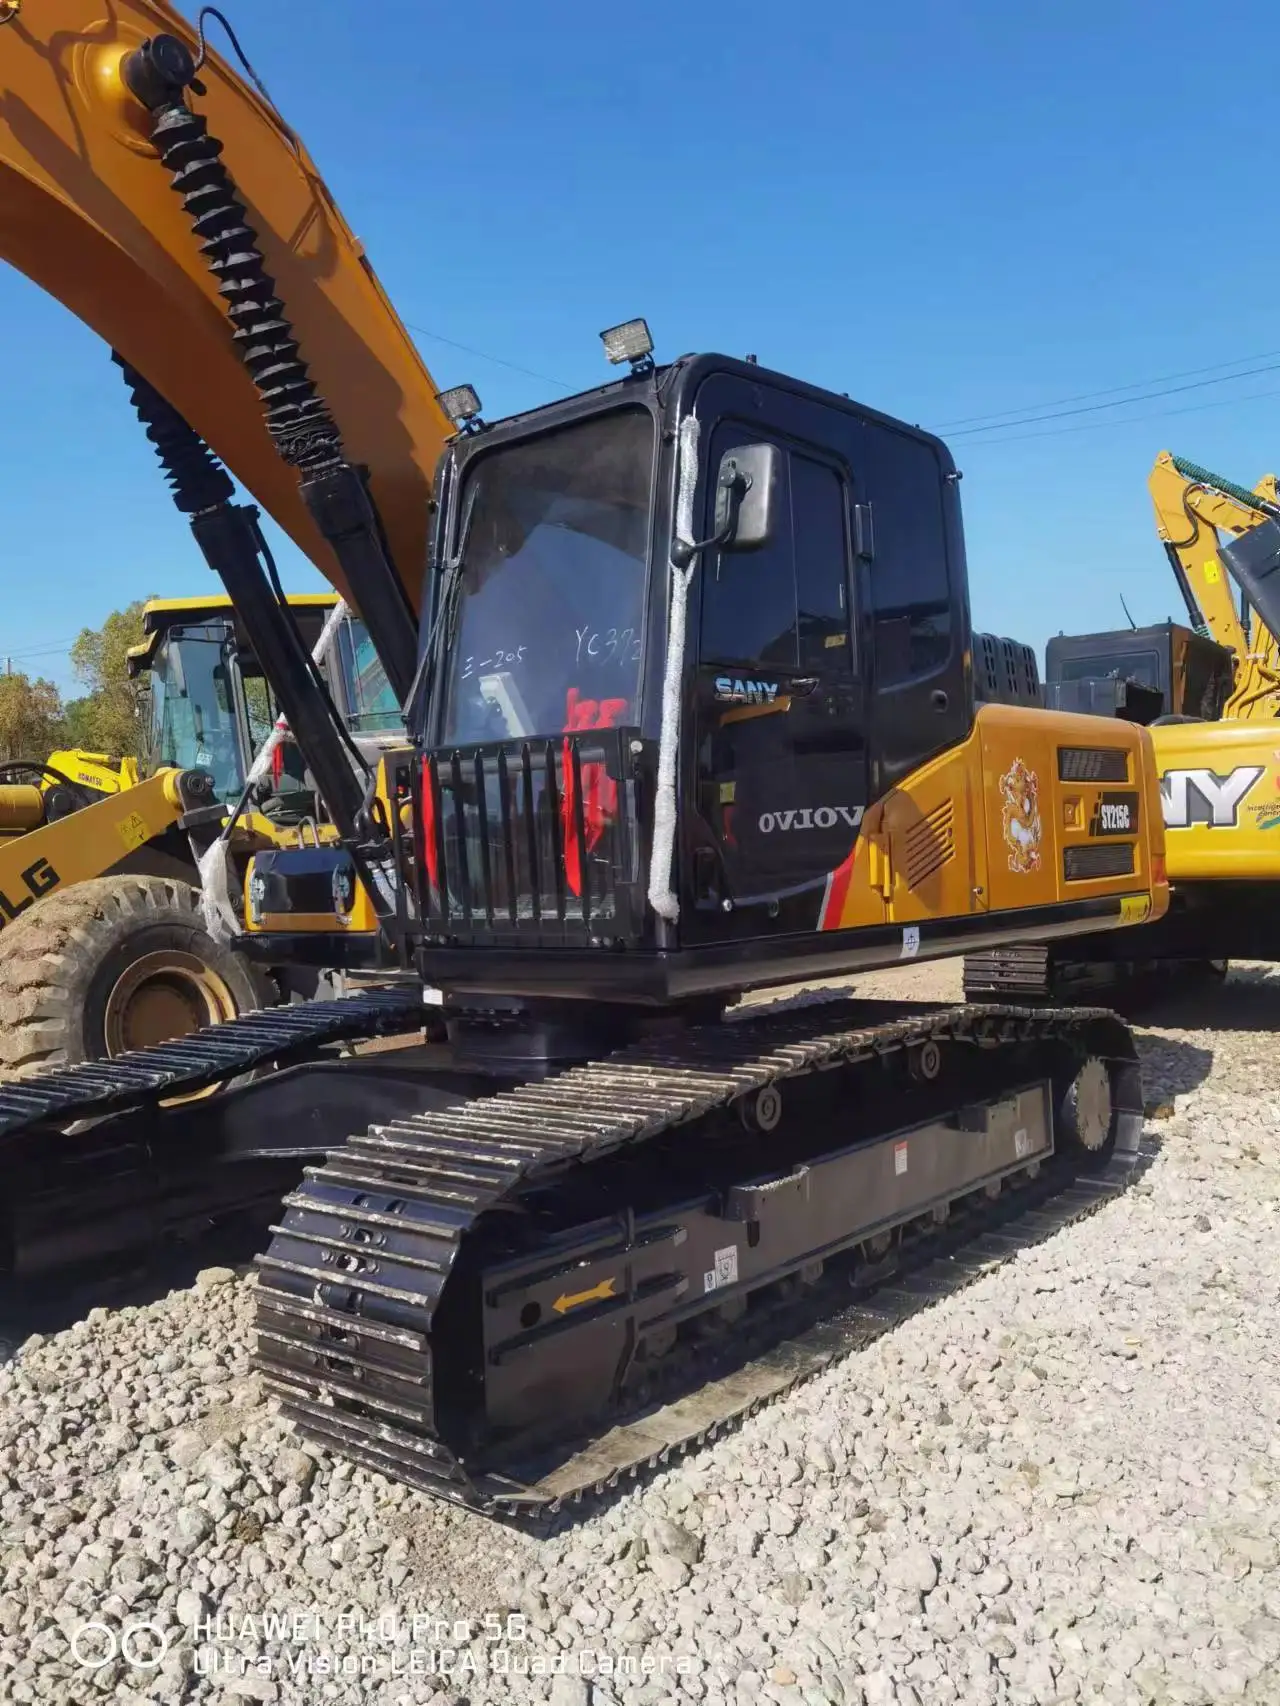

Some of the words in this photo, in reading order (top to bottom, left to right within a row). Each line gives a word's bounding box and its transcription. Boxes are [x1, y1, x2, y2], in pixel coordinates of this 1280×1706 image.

[715, 677, 778, 704] SANY
[1101, 804, 1130, 829] SY215C
[0, 857, 61, 931] LG
